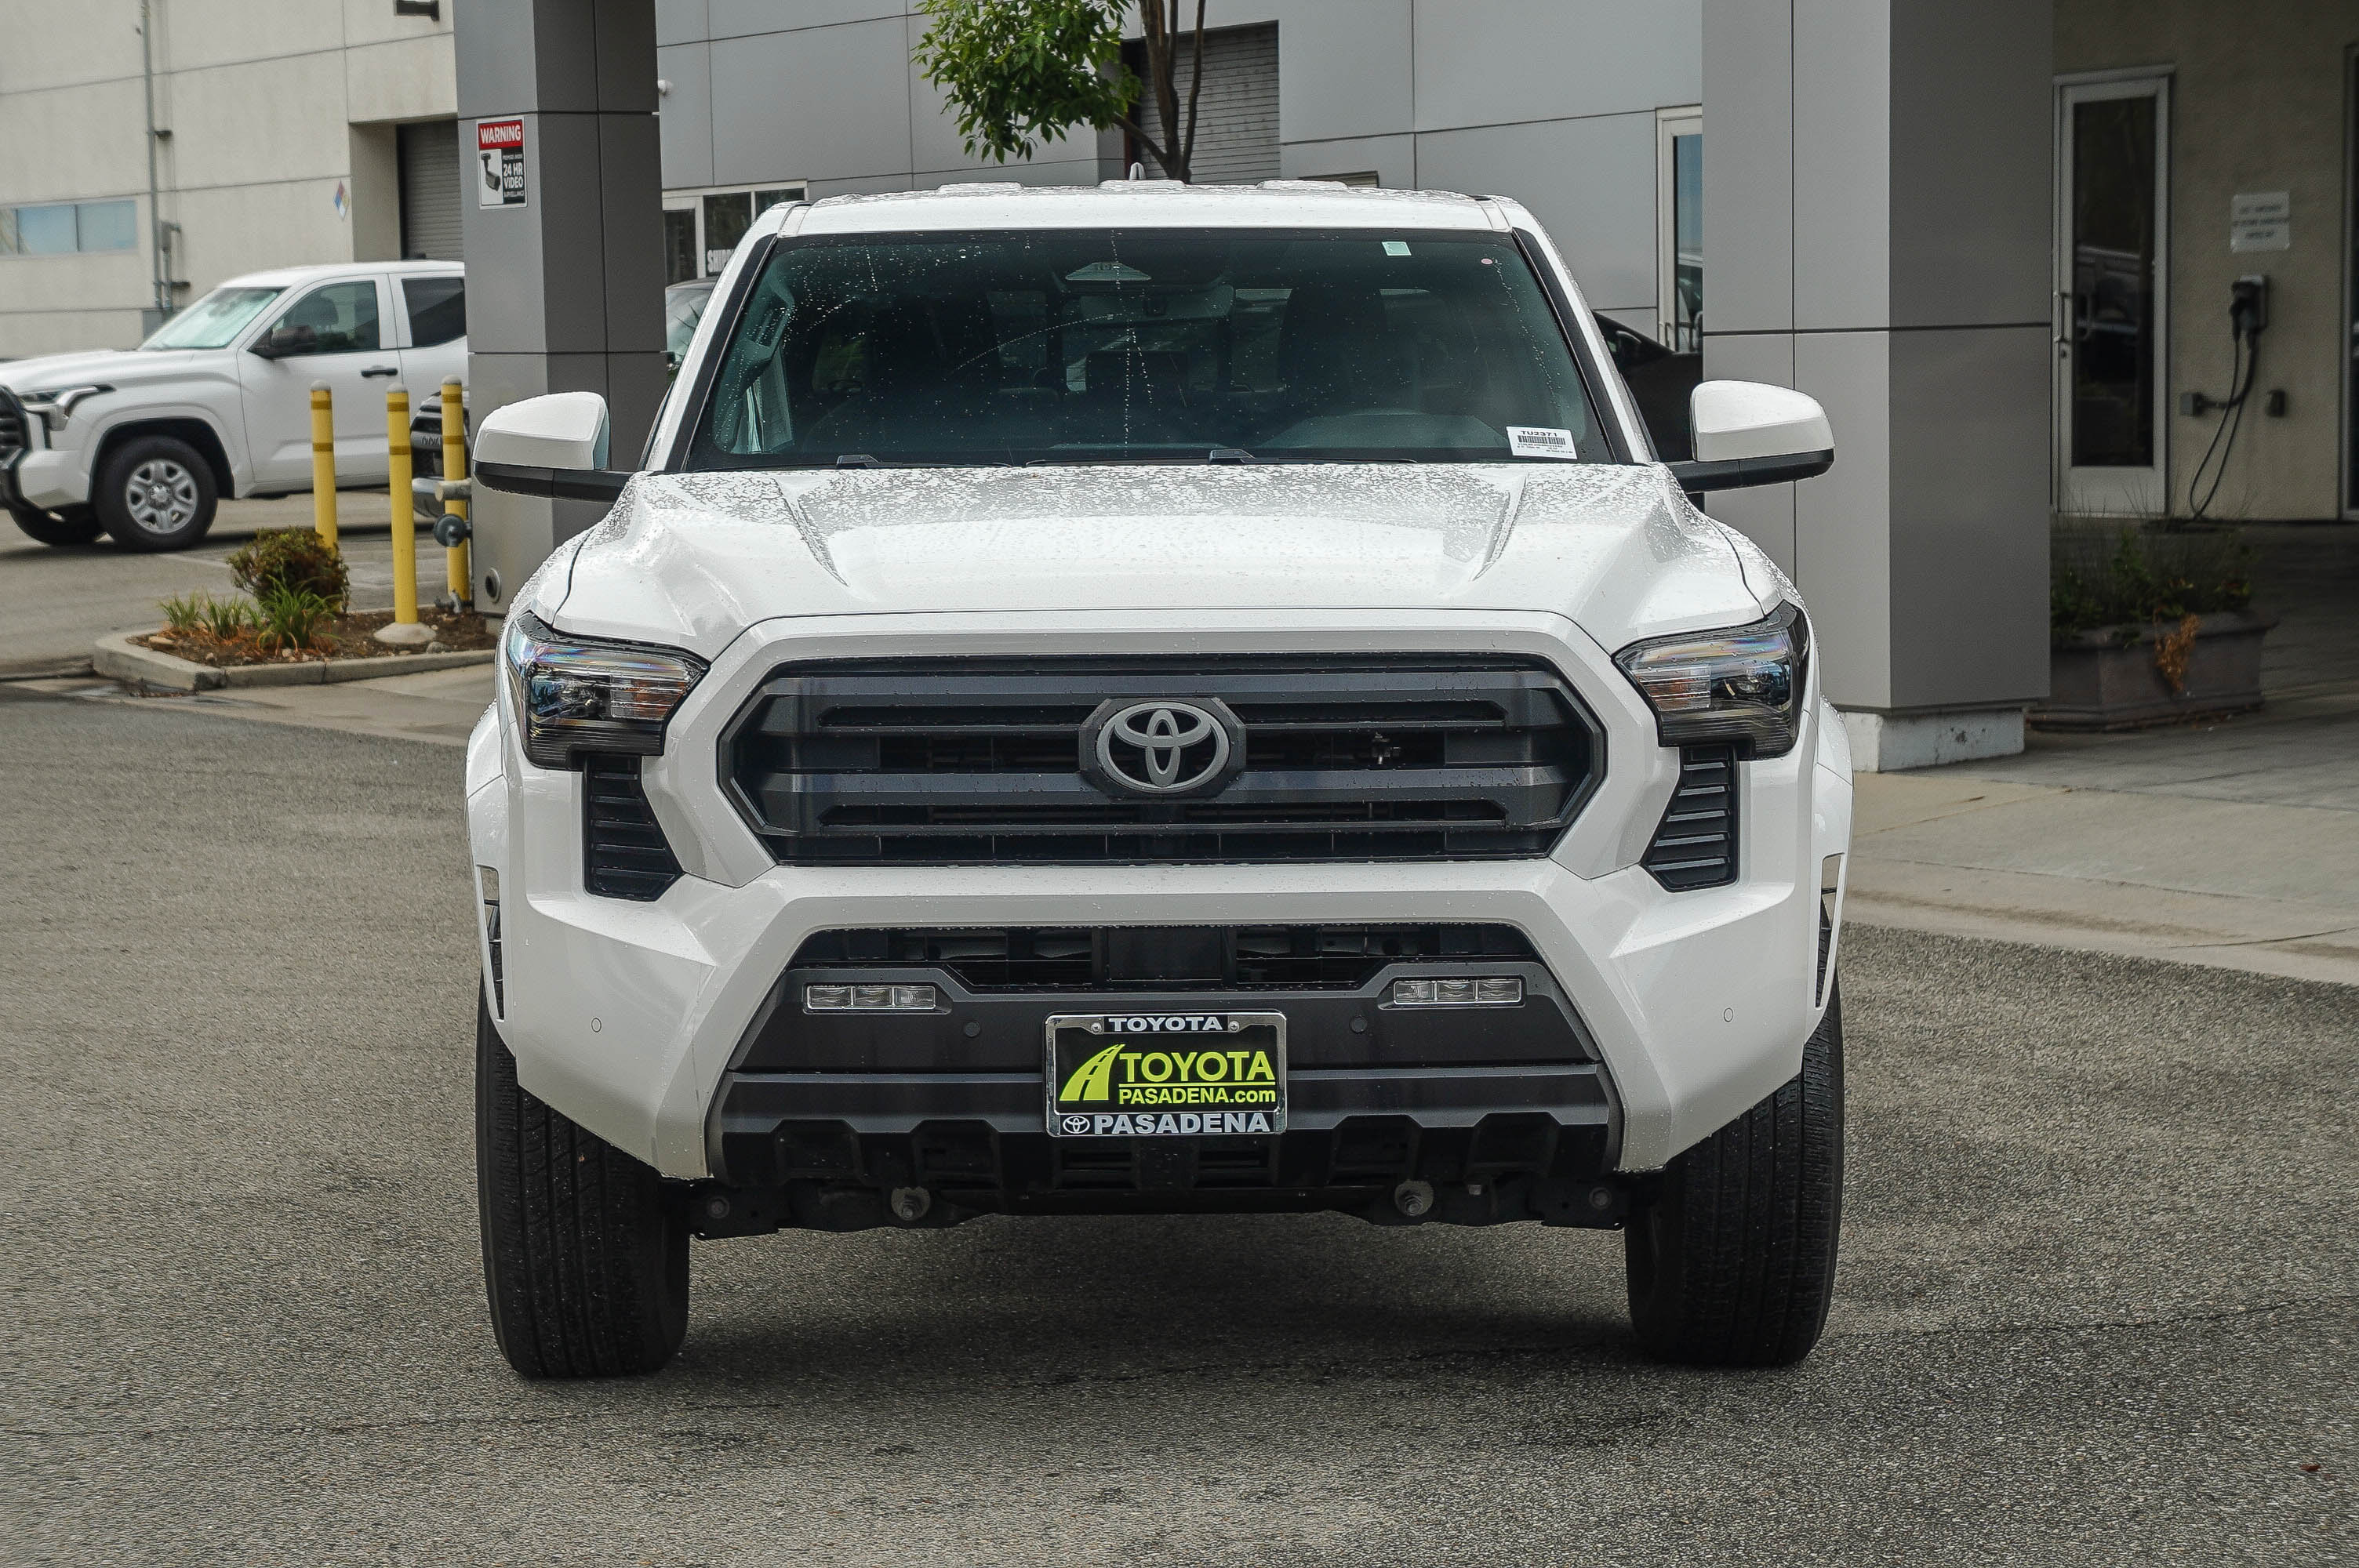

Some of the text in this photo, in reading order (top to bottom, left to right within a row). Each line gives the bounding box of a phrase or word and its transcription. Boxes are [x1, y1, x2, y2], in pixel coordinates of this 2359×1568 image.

[480, 124, 522, 144] WARNING
[503, 162, 523, 177] 24 HR
[503, 176, 524, 189] VIDEO
[1108, 1017, 1223, 1032] TOYOTA
[1118, 1051, 1276, 1083] TOYOTA
[1118, 1087, 1276, 1105] PASADENA.com
[1095, 1113, 1271, 1134] PASADENA
